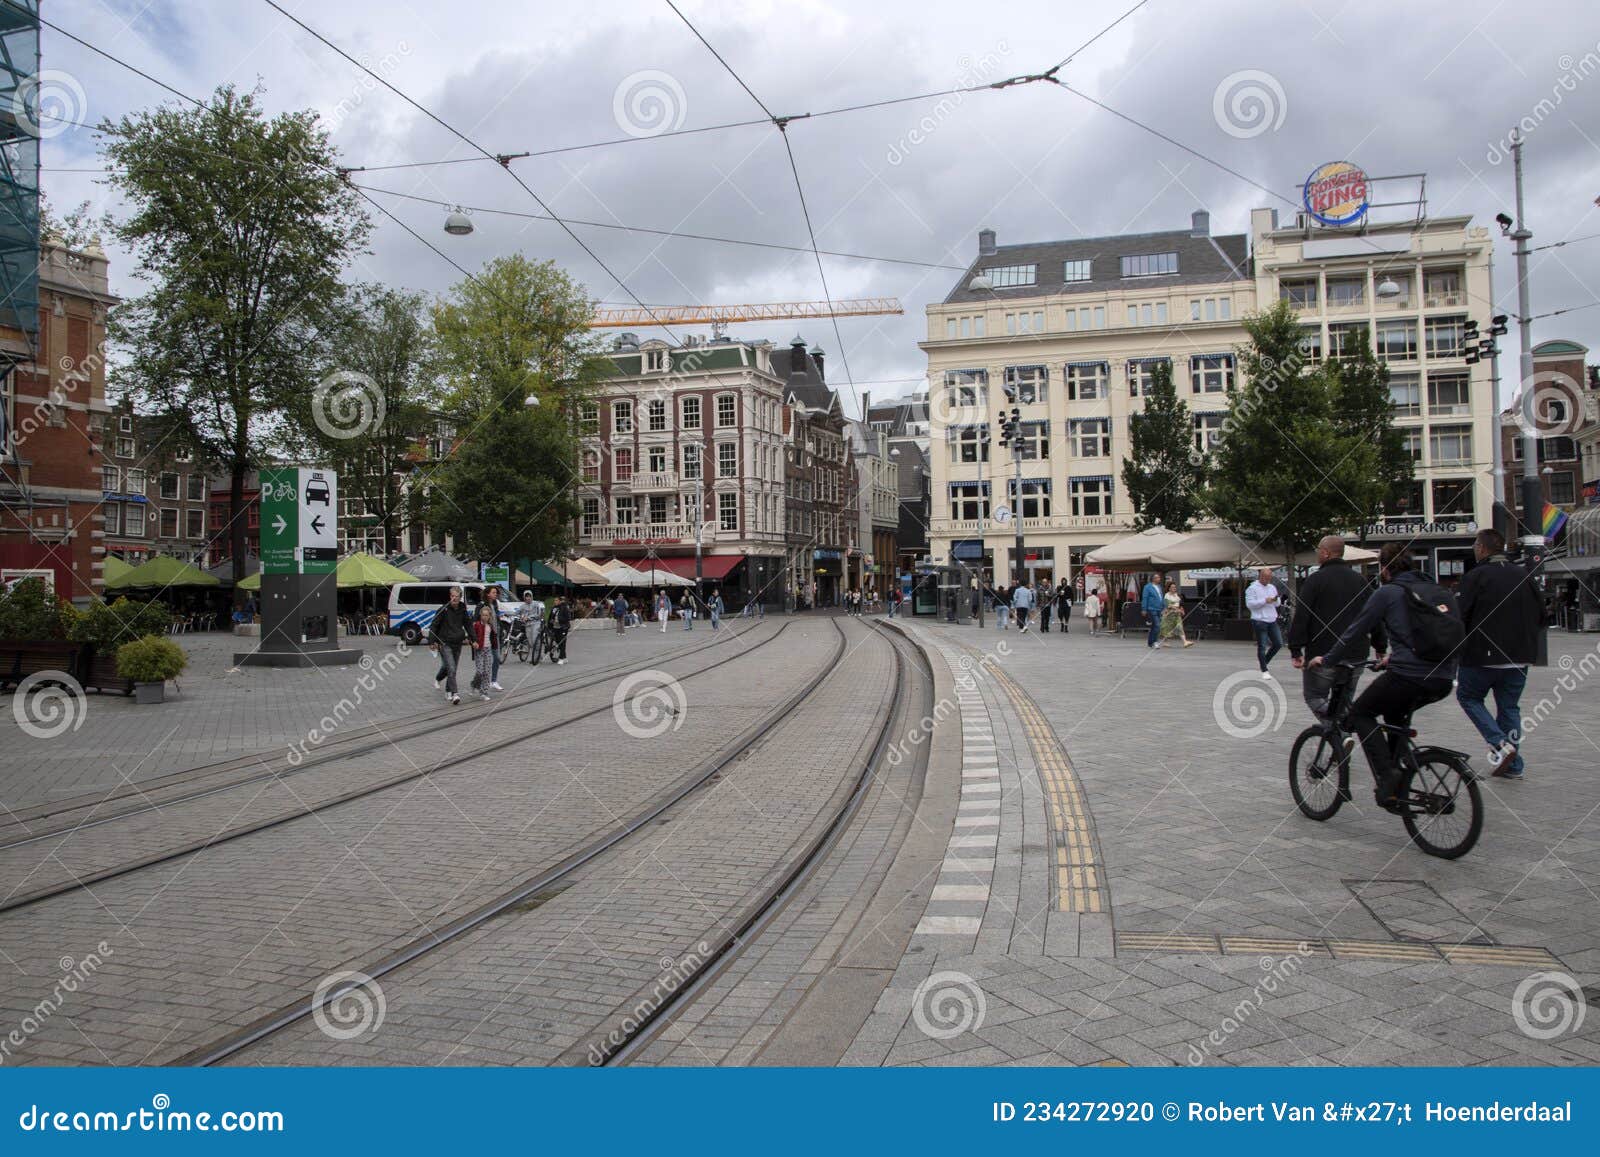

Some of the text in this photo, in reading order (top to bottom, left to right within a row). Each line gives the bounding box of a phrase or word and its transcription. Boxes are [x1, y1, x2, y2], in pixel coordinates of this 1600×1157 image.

[1311, 170, 1363, 196] BURGER
[1313, 181, 1366, 212] KING
[262, 483, 273, 502] P
[1419, 520, 1457, 533] KING
